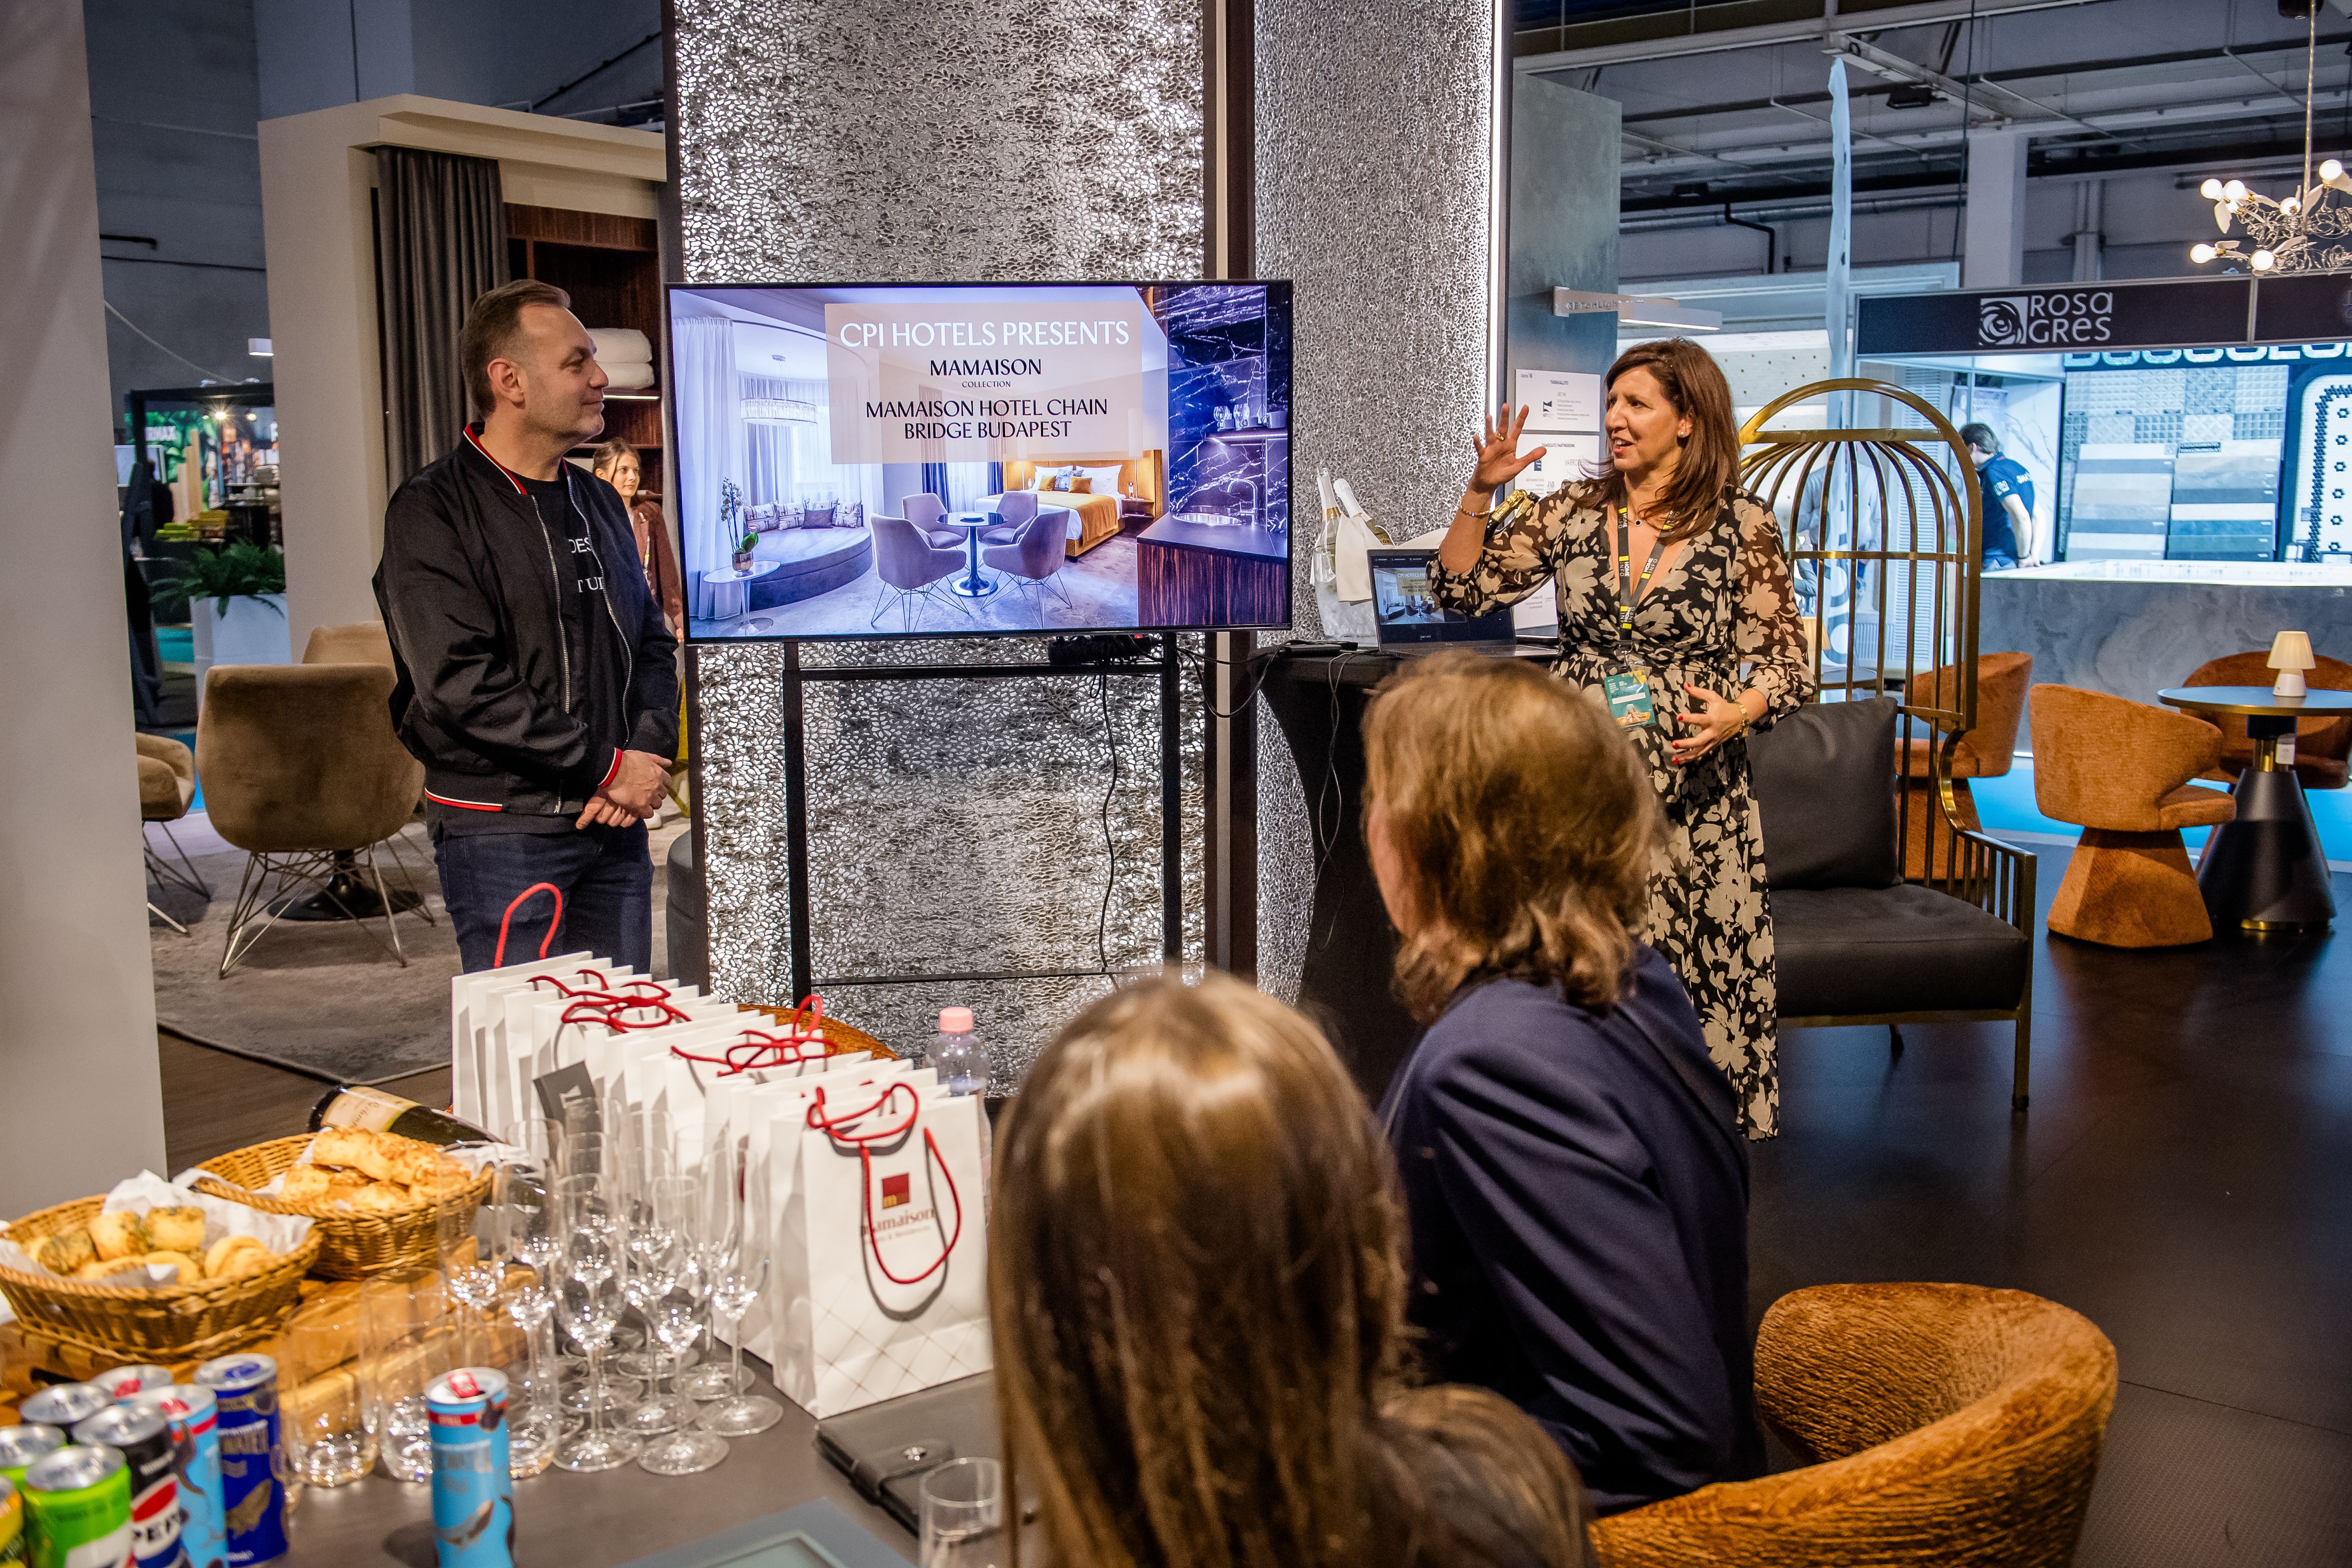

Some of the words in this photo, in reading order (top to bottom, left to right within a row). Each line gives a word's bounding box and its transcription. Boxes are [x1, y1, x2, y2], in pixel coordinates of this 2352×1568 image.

[840, 322, 884, 348] CPI
[892, 321, 997, 347] HOTELS
[1004, 320, 1130, 346] PRESENTS
[930, 358, 1042, 376] MAMAISON
[866, 400, 974, 418] MAMAISON
[980, 399, 1043, 417] HOTEL
[1047, 398, 1108, 416] CHAIN
[905, 422, 972, 439] BRIDGE
[978, 421, 1072, 438] BUDAPEST
[1643, 557, 1654, 573] HOME
[1648, 559, 1658, 573] INFO
[1623, 606, 1632, 622] HOME
